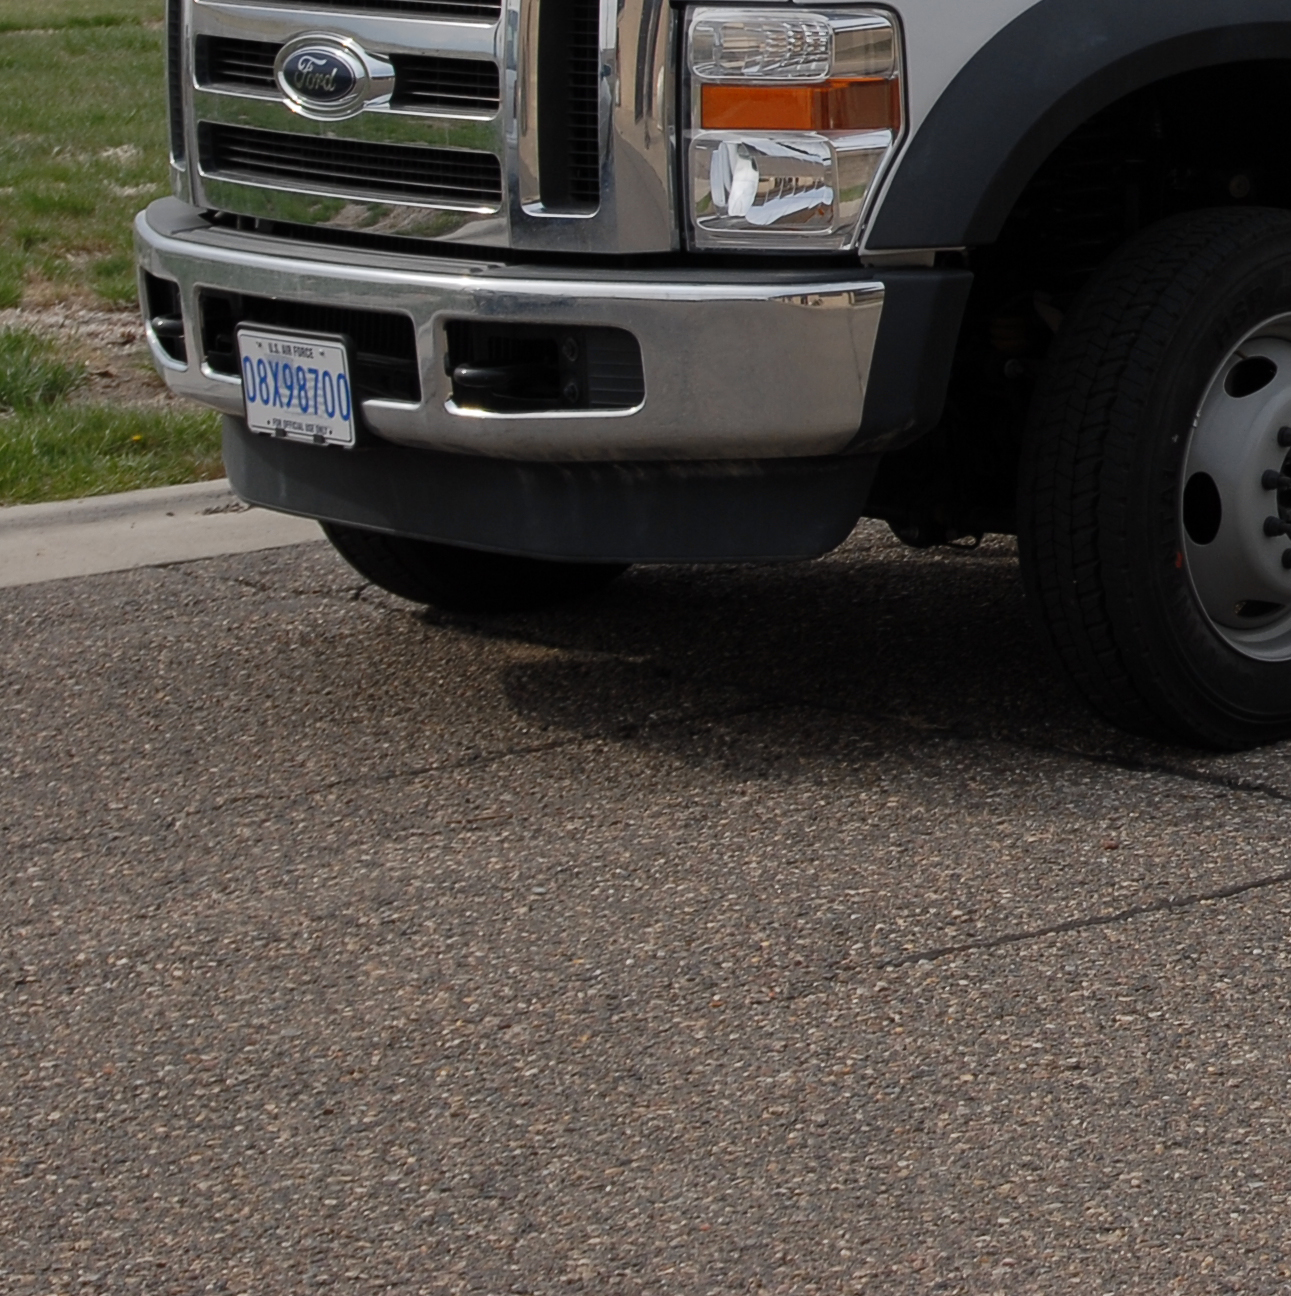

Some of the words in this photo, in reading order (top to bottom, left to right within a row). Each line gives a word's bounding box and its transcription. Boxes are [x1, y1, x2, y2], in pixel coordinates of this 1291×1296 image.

[294, 54, 339, 92] Ford
[268, 342, 280, 354] U.S.
[282, 345, 292, 356] AIR
[293, 346, 314, 359] FORCE
[243, 356, 350, 421] 08X98700
[272, 417, 282, 428] FOR
